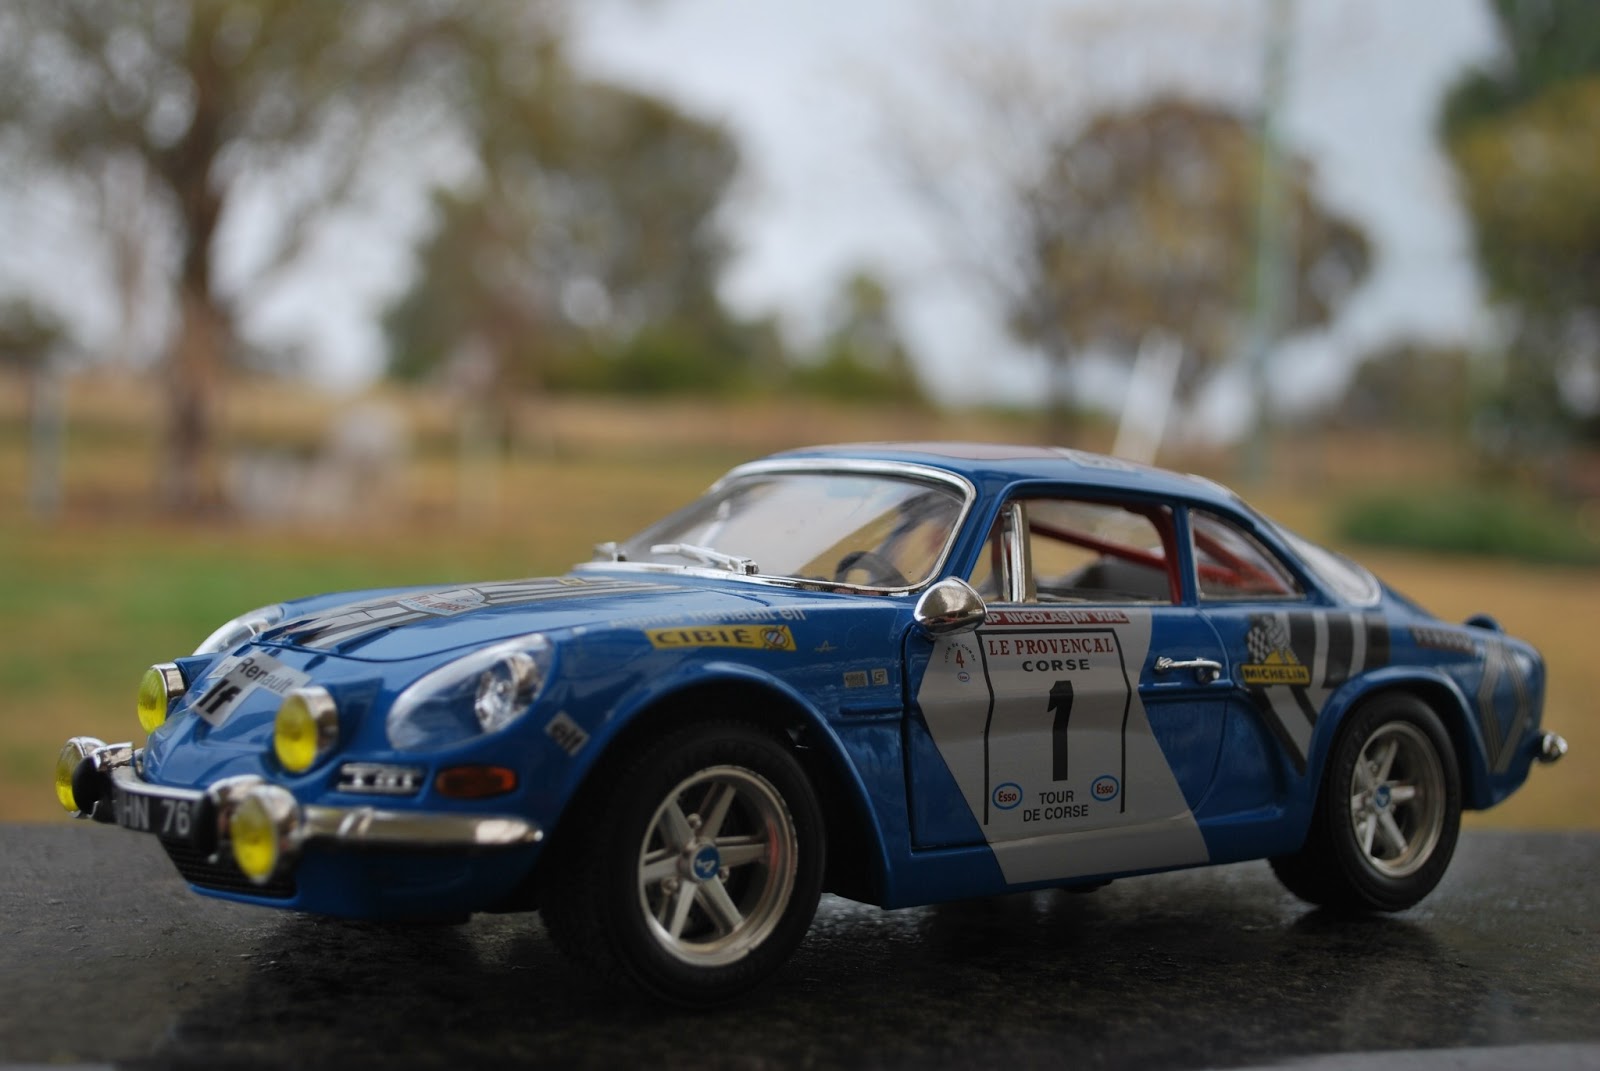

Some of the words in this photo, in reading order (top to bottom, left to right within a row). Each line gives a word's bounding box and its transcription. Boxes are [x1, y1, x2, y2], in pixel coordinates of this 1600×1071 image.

[1004, 611, 1070, 624] NICOLAS
[1073, 611, 1089, 622] M
[1092, 610, 1127, 622] VIAL
[988, 640, 1010, 655] LE
[1014, 637, 1114, 656] PROVENÇAL
[956, 649, 965, 669] 4
[1022, 659, 1091, 673] CORSE
[238, 656, 294, 694] Renault
[1244, 667, 1307, 680] MICHELIN
[551, 722, 585, 751] elf
[1047, 679, 1074, 782] 1
[998, 790, 1017, 803] Esso
[1039, 790, 1074, 805] TOUR
[1095, 782, 1114, 795] Esso
[162, 799, 191, 835] 76
[1023, 809, 1041, 823] DE
[1044, 804, 1090, 820] CORSE
